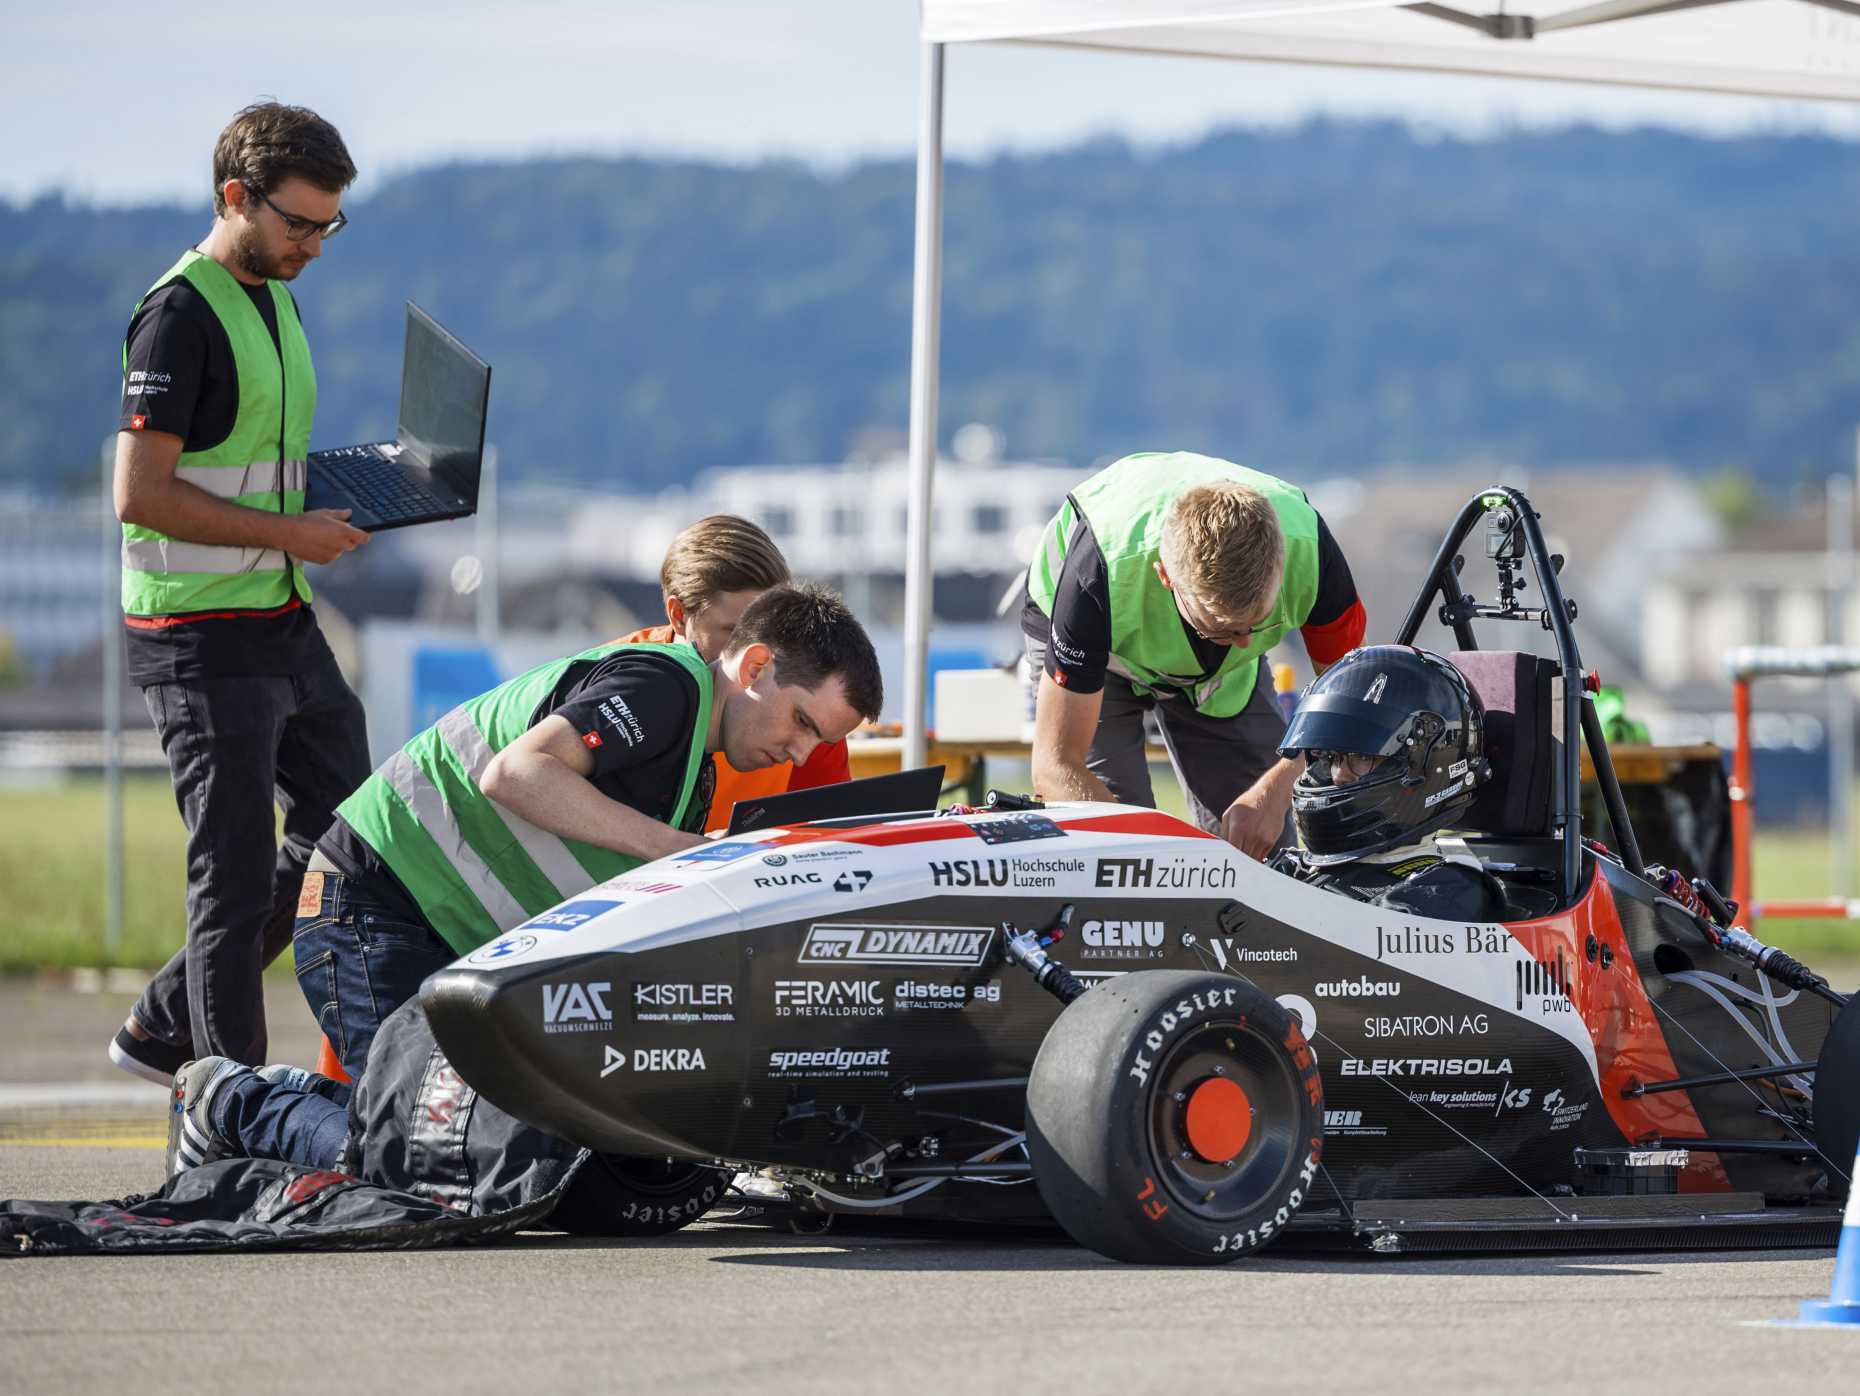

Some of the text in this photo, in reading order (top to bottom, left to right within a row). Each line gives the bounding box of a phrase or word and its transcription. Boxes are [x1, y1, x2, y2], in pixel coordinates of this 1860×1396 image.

[598, 702, 621, 725] HSLU
[928, 859, 1009, 887] HSLU
[1012, 858, 1085, 873] Hochschule
[753, 872, 823, 888] RUAG
[1013, 875, 1056, 888] Luzern
[809, 930, 987, 958] CNC DYNAMIX
[1081, 920, 1166, 947] GENU
[1376, 926, 1513, 960] Julius Bär
[1081, 950, 1164, 959] PARTNER AG
[1236, 947, 1298, 962] Vincotech
[634, 984, 733, 1005] KISTLER
[775, 980, 885, 1005] FERAMIC
[895, 980, 1001, 1002] distec ag
[1314, 975, 1401, 997] autobau
[542, 982, 613, 1023] VAC
[775, 1007, 884, 1017] 3D METALLDRUCK
[895, 1001, 965, 1009] METALLTECHNIK
[1542, 999, 1571, 1016] pwb
[1364, 1014, 1489, 1038] SIBATRON AG
[633, 1048, 707, 1072] DEKRA
[769, 1047, 891, 1070] speedgoat
[1341, 1058, 1513, 1076] ELEKTRISOLA
[1408, 1090, 1497, 1105] lean key solutions
